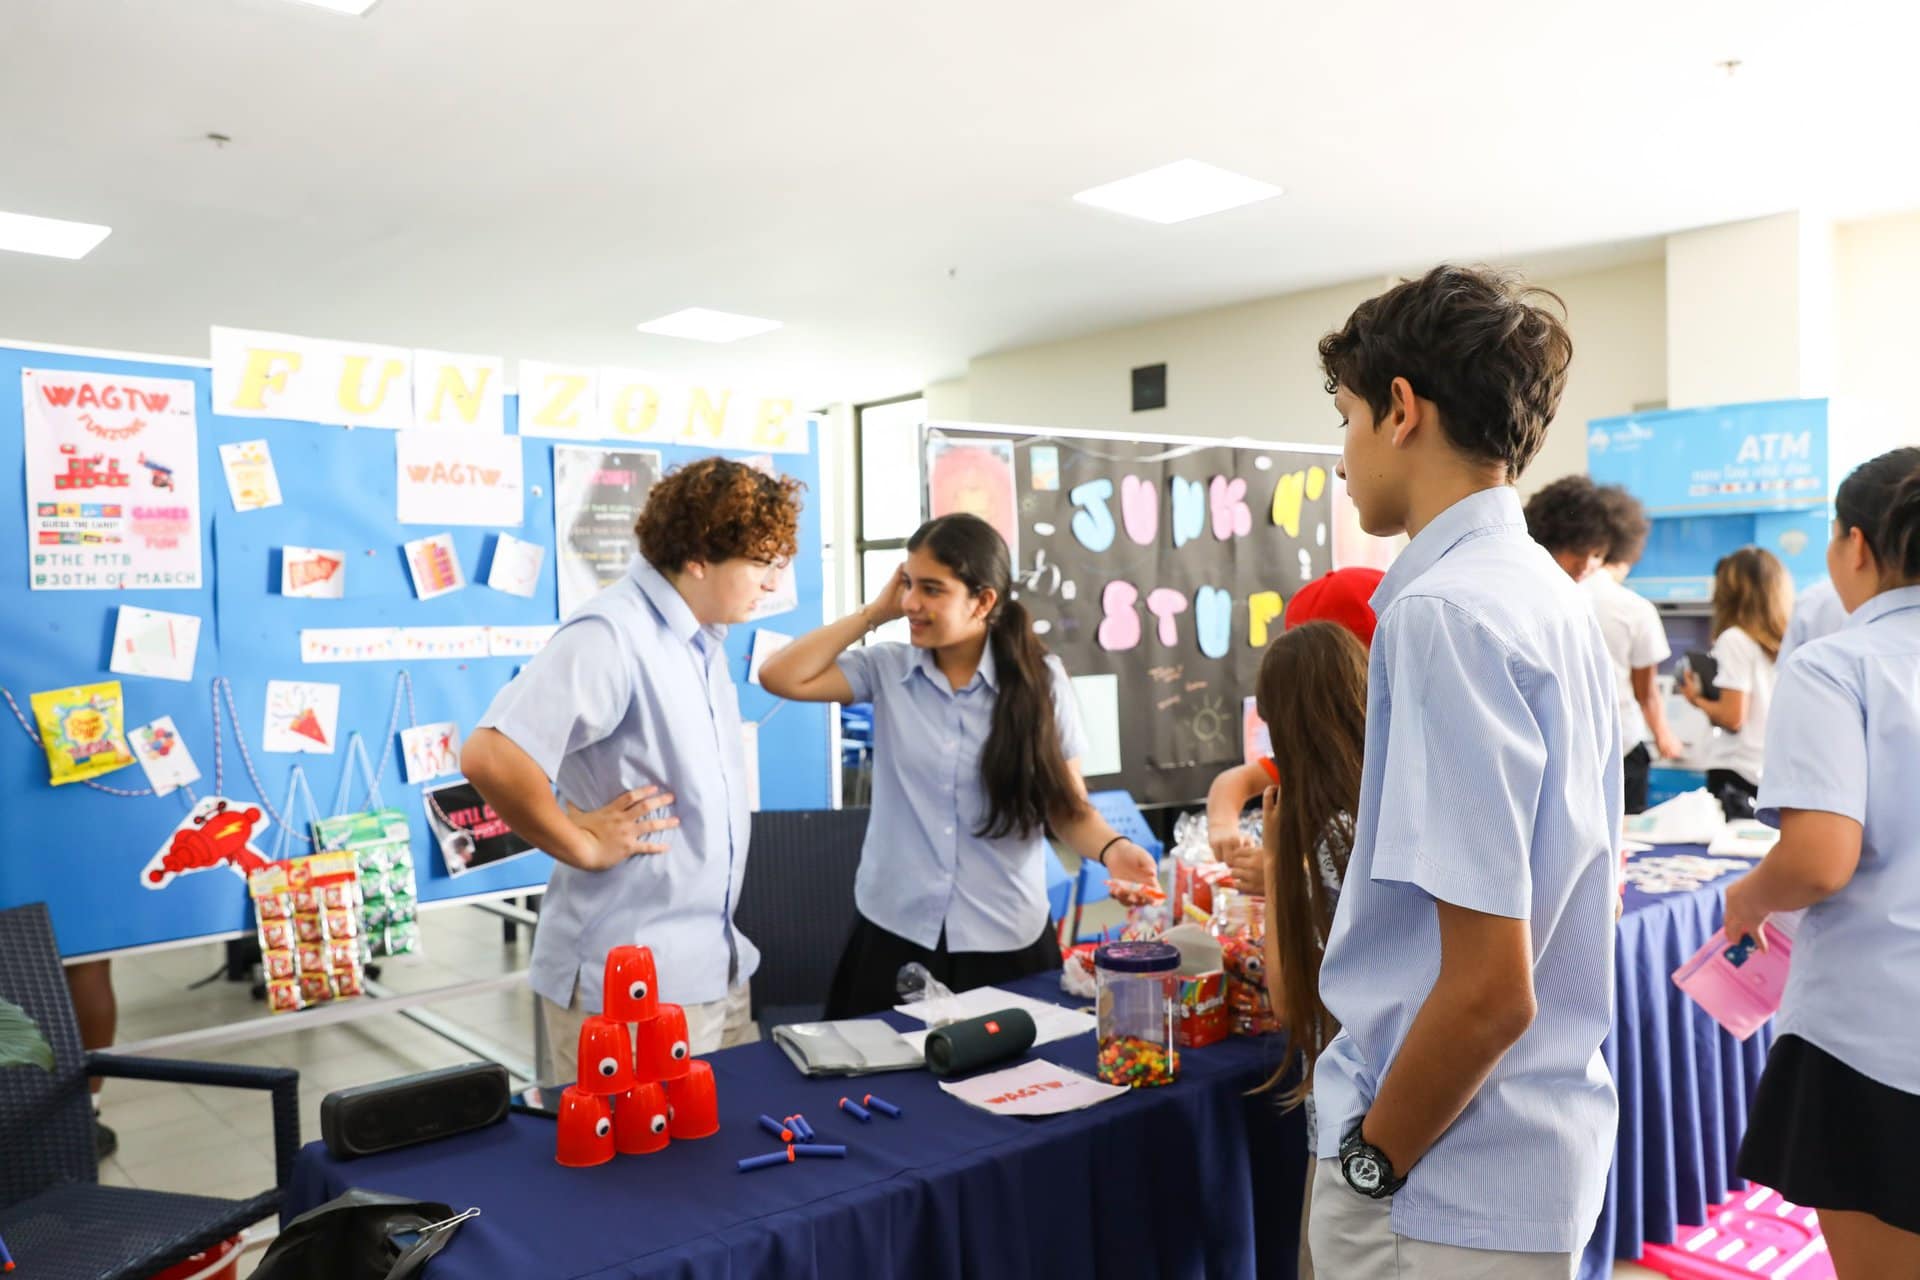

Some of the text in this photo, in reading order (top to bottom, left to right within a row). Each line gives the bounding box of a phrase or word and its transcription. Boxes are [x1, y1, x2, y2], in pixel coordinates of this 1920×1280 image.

[42, 383, 170, 413] WAGTW
[230, 347, 794, 447] FUN ZONE
[1736, 430, 1812, 464] ATM
[406, 461, 502, 486] WAGTW
[1070, 474, 1252, 553] JUNK
[50, 553, 84, 566] THE
[105, 573, 128, 586] OF
[136, 571, 196, 585] MARCH
